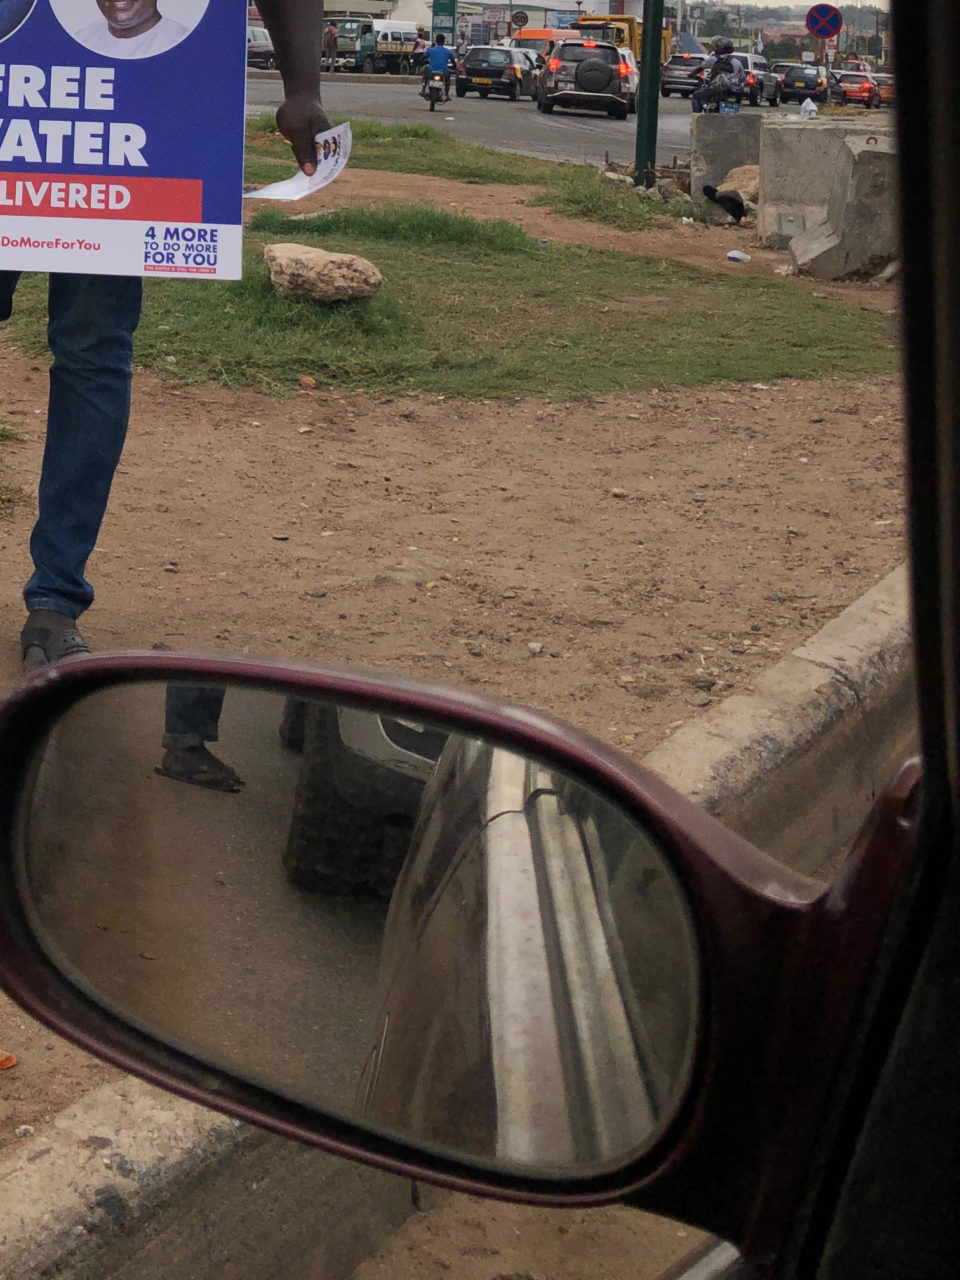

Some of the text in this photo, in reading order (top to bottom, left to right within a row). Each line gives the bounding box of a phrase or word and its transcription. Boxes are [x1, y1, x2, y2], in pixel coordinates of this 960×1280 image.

[145, 226, 218, 243] 4 MORE
[144, 241, 218, 254] TO DO MORE
[144, 251, 218, 266] FOR YOU
